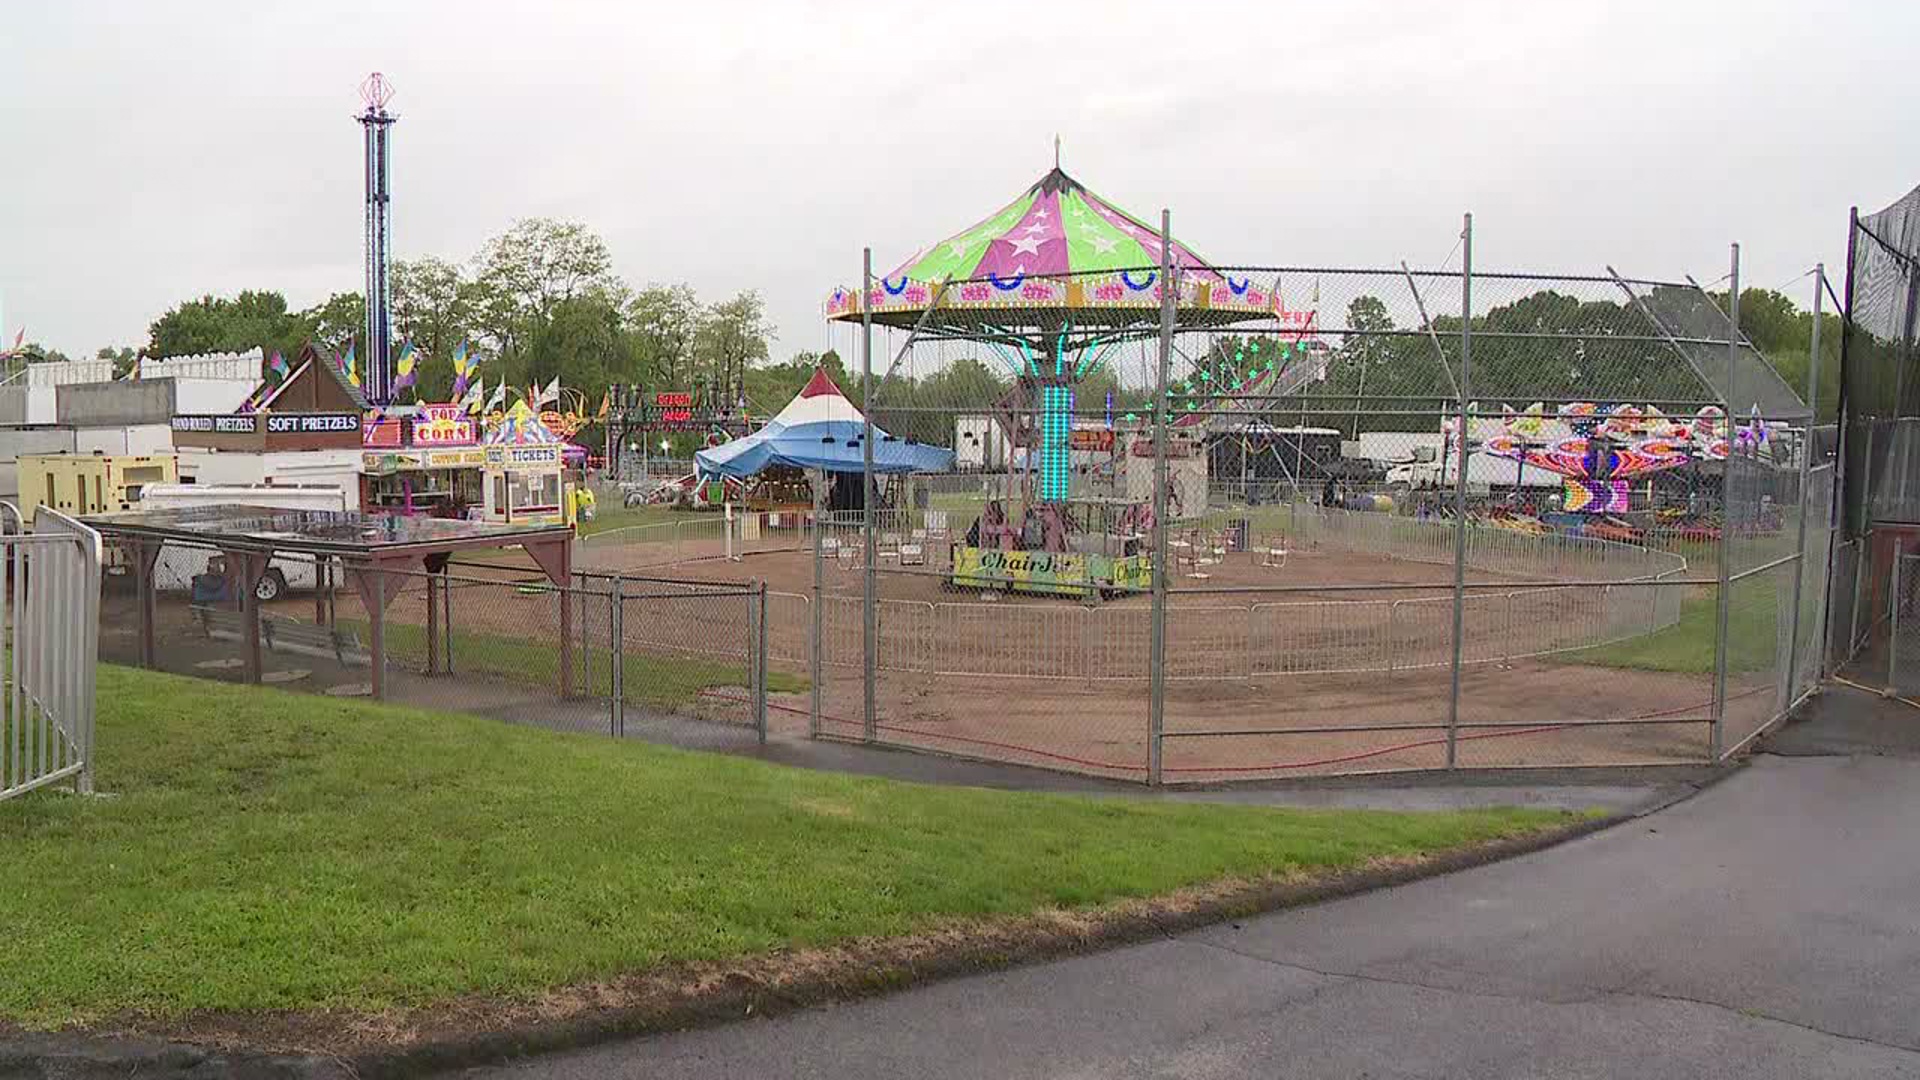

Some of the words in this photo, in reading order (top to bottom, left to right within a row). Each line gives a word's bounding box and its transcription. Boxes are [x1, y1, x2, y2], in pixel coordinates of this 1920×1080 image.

[431, 407, 457, 420] POP
[215, 417, 255, 432] PRETZELS
[268, 417, 299, 432] SOFT
[302, 416, 358, 431] PRETZELS
[418, 427, 467, 440] CORN
[512, 449, 556, 462] TICKETS
